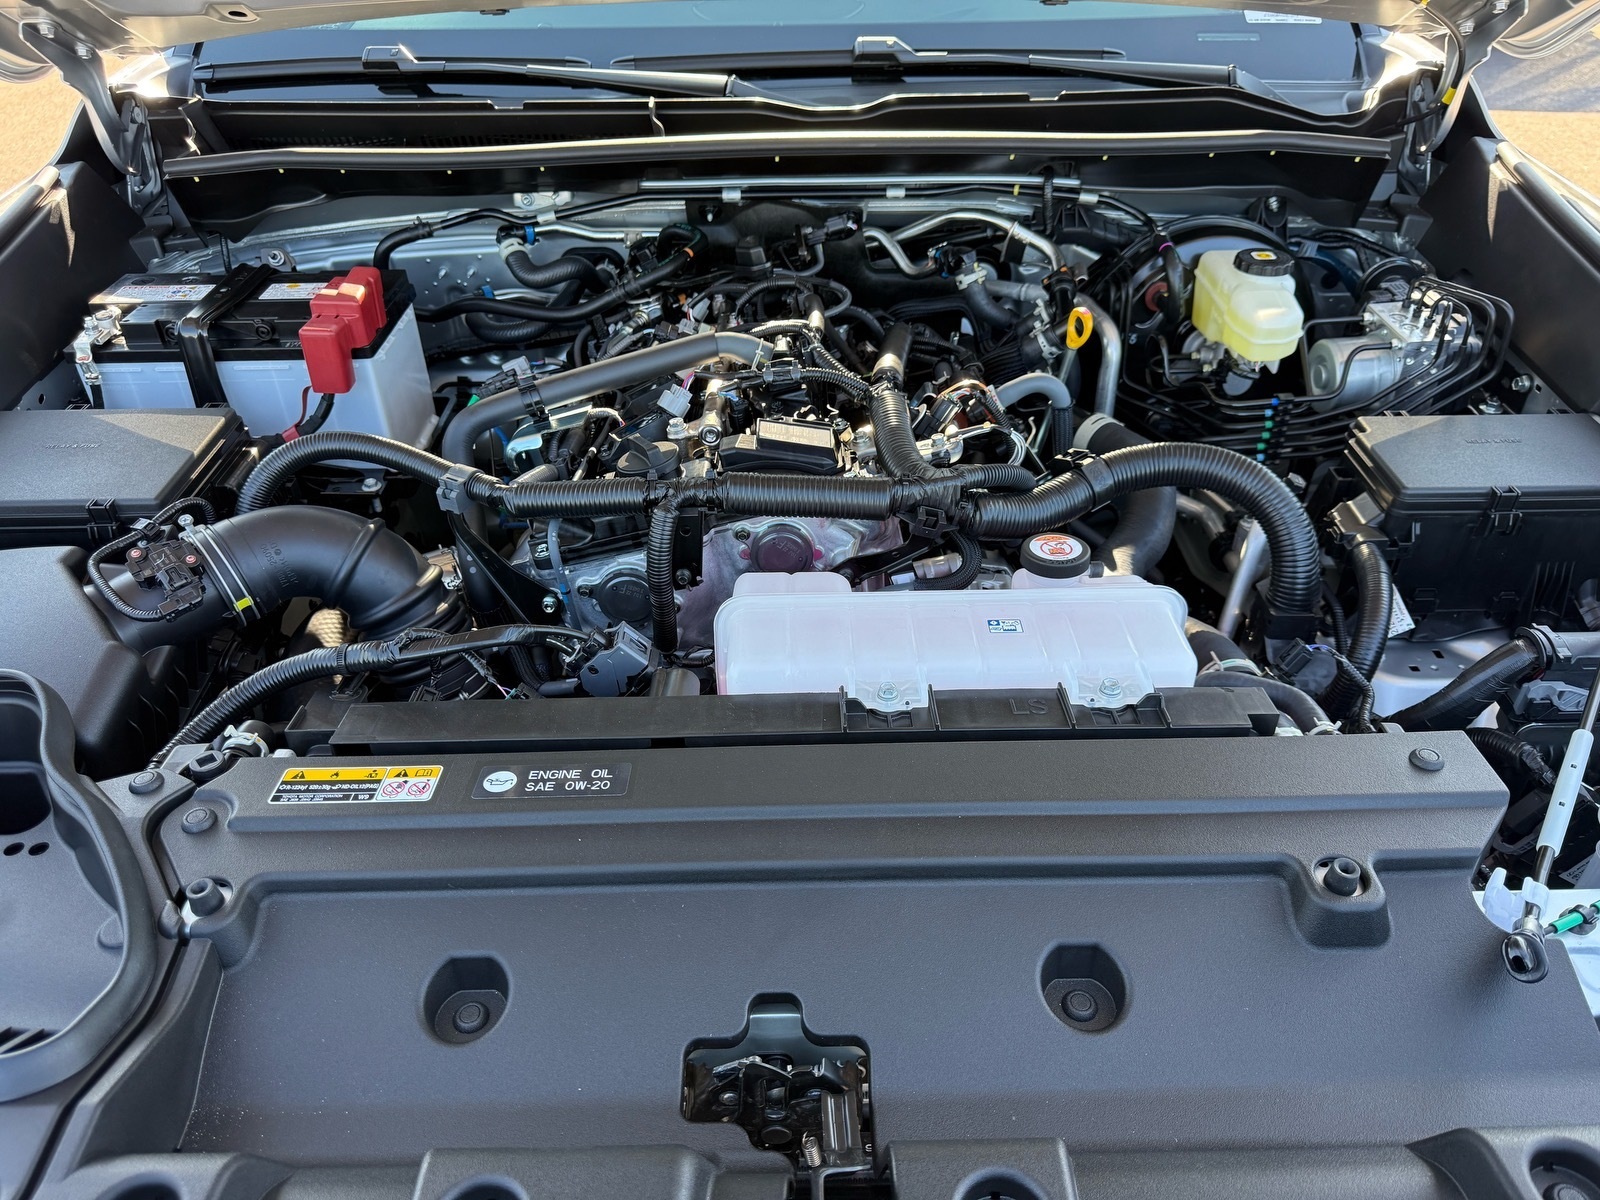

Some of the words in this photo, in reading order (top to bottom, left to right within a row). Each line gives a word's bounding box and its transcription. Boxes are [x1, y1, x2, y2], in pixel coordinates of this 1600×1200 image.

[1009, 698, 1049, 715] LS
[528, 769, 582, 780] ENGINE
[591, 769, 613, 778] OIL
[524, 781, 556, 792] SAE
[565, 780, 611, 790] 0W-20
